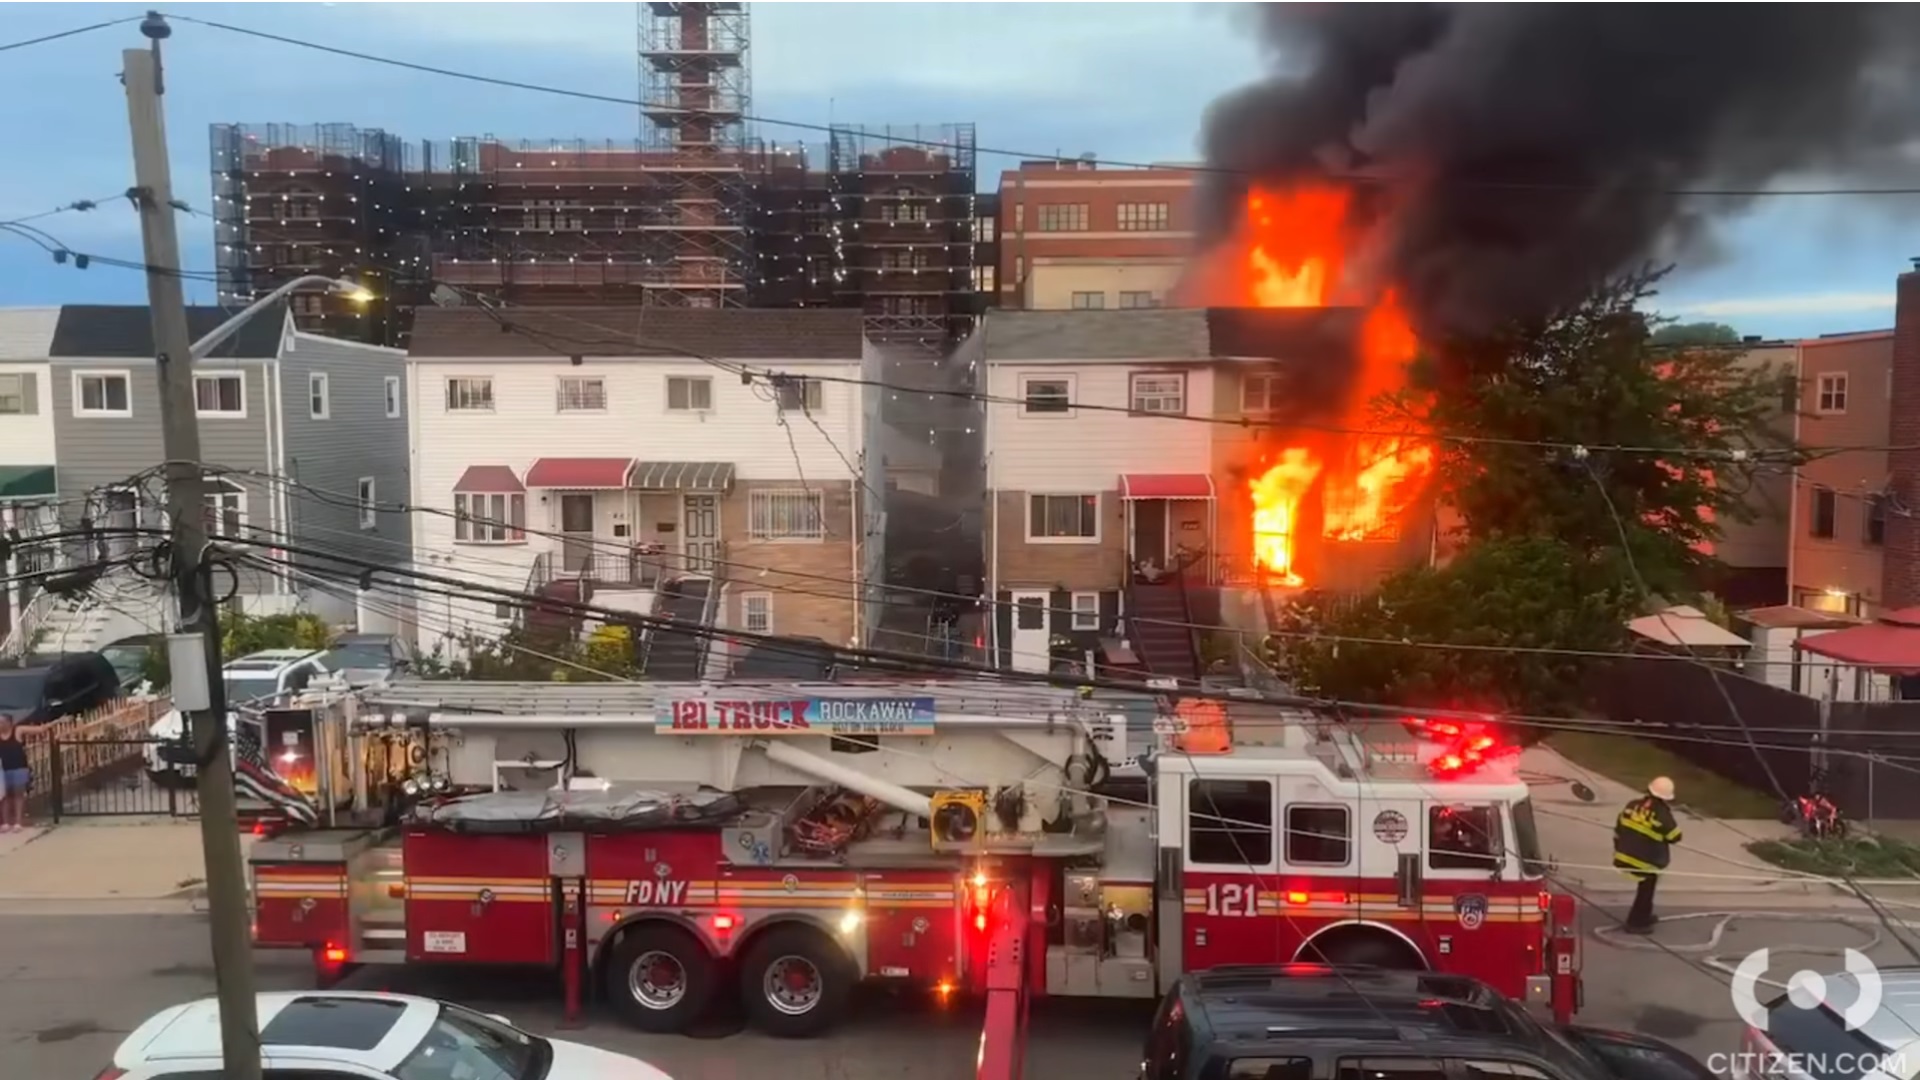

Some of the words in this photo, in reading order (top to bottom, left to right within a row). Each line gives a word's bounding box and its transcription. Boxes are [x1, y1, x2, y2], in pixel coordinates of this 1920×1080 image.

[671, 700, 708, 729] 121
[713, 700, 810, 729] TRUCK
[820, 701, 916, 720] ROCKAWAY
[1206, 883, 1257, 917] 121
